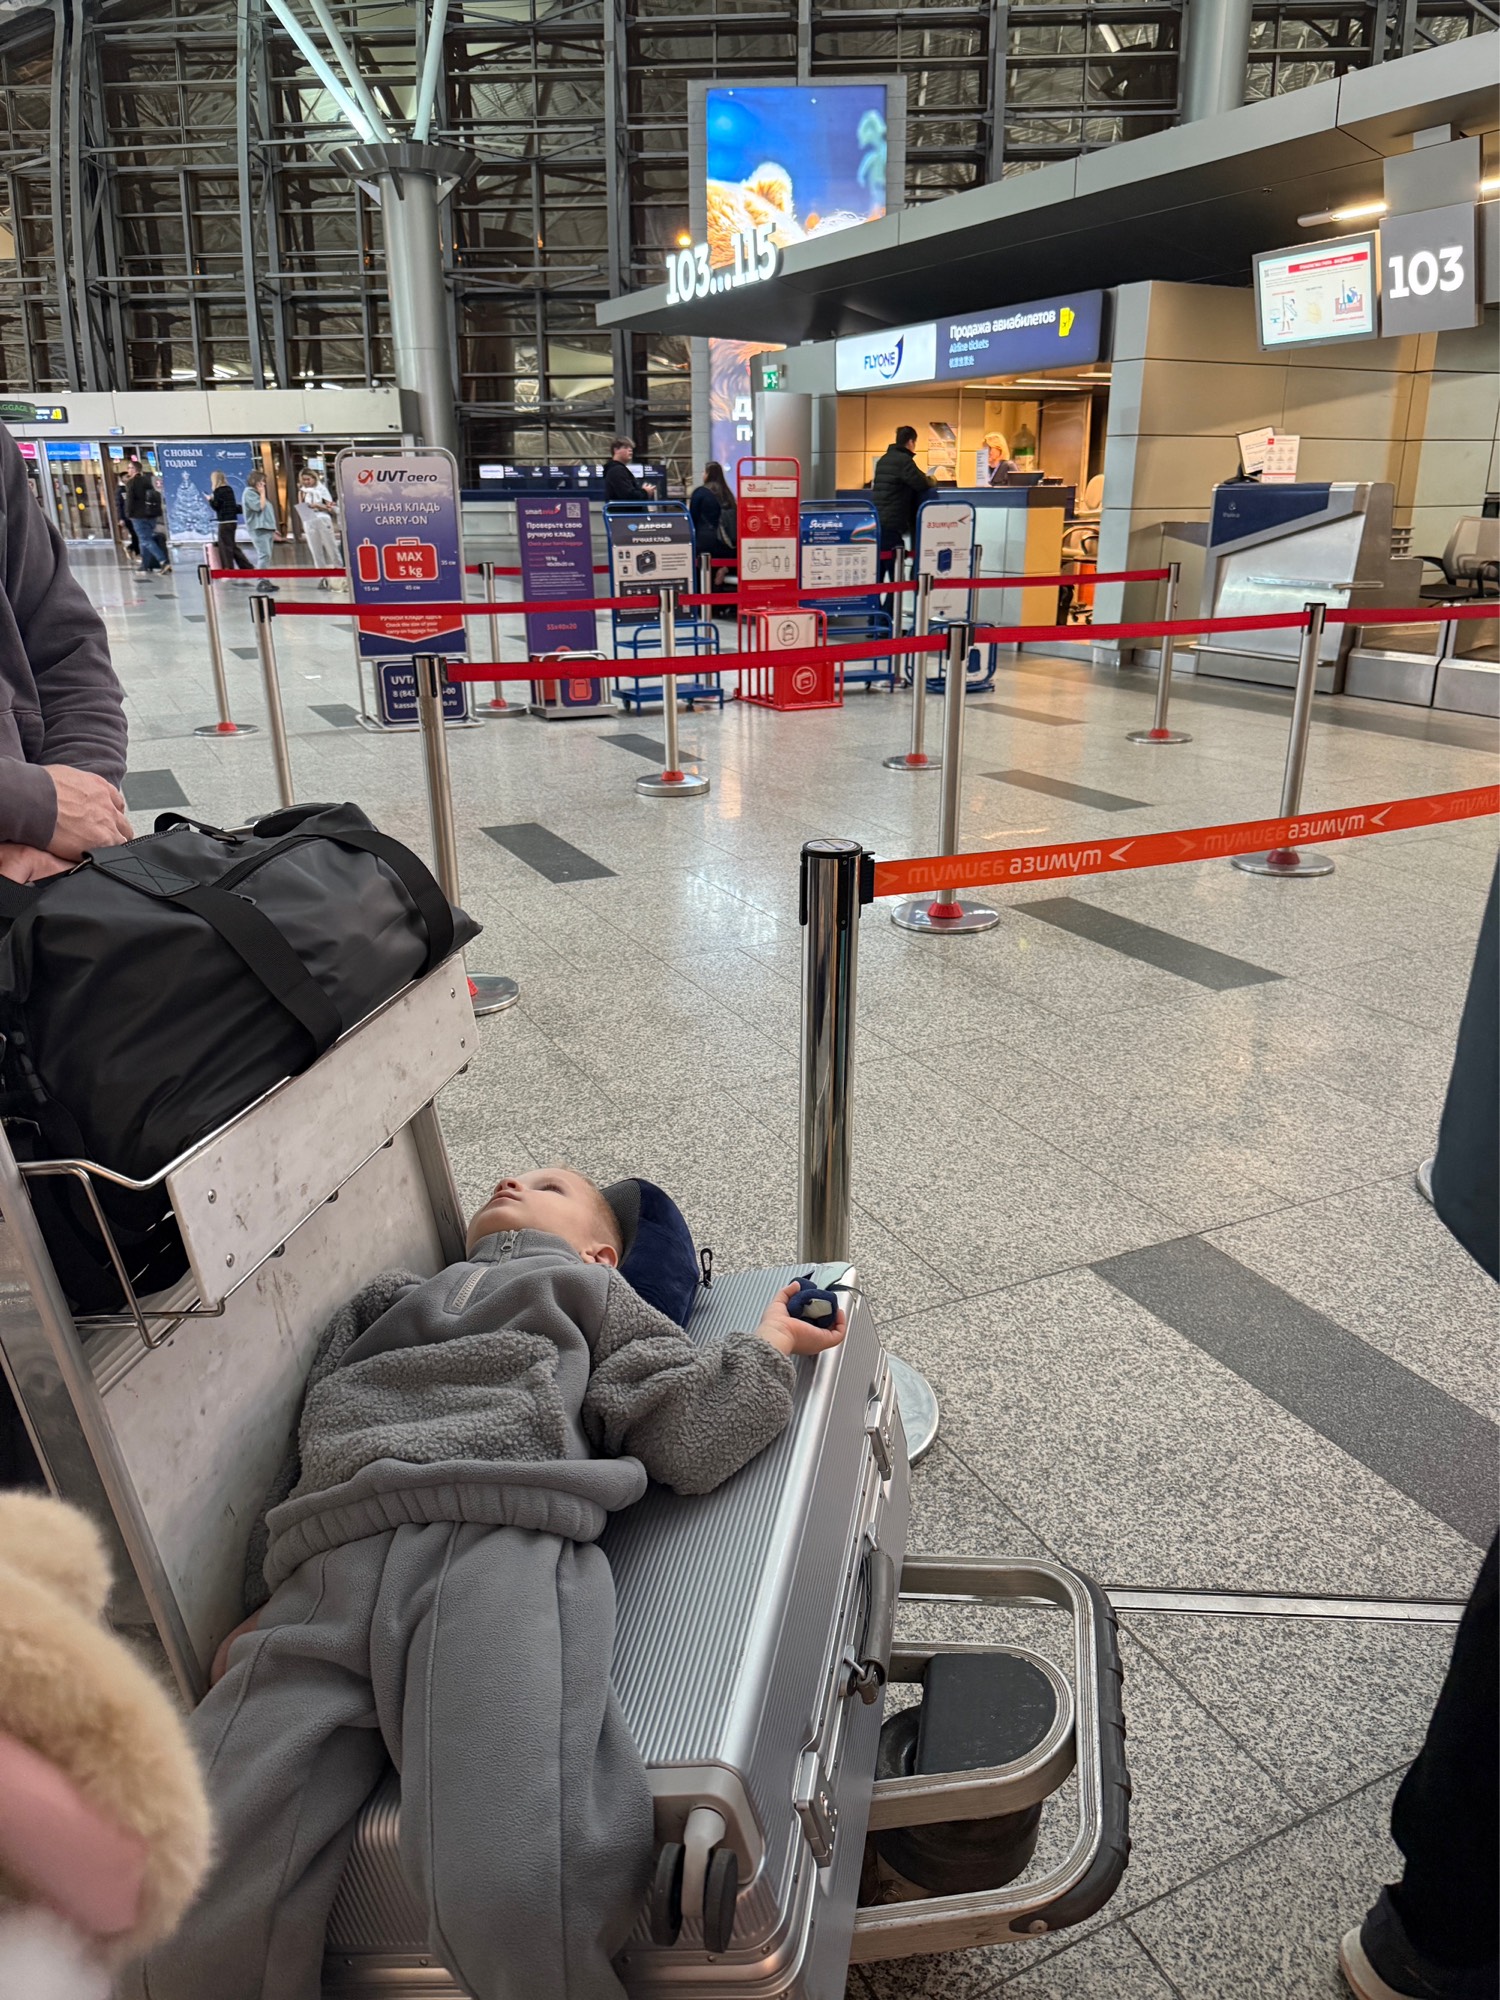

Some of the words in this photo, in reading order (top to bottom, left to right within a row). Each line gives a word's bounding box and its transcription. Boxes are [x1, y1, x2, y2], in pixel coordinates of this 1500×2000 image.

[1388, 245, 1465, 299] 103
[950, 321, 991, 341] Продажа
[992, 310, 1056, 334] авиабилетов
[864, 352, 895, 369] FLYONE
[163, 449, 169, 457] С
[170, 449, 203, 457] НОВЫМ
[165, 459, 197, 468] ГОДОМ!
[376, 470, 407, 482] UVT
[407, 474, 438, 482] aero
[360, 502, 402, 513] РУЧНАЯ
[405, 502, 441, 513] КЛАДЬ
[375, 516, 428, 525] CARRY-ON
[526, 522, 563, 530] Проверьте
[396, 551, 423, 562] MAX
[399, 566, 406, 576] 5
[409, 566, 423, 578] kg
[1288, 813, 1364, 839] азимут
[1009, 848, 1102, 875] азимут
